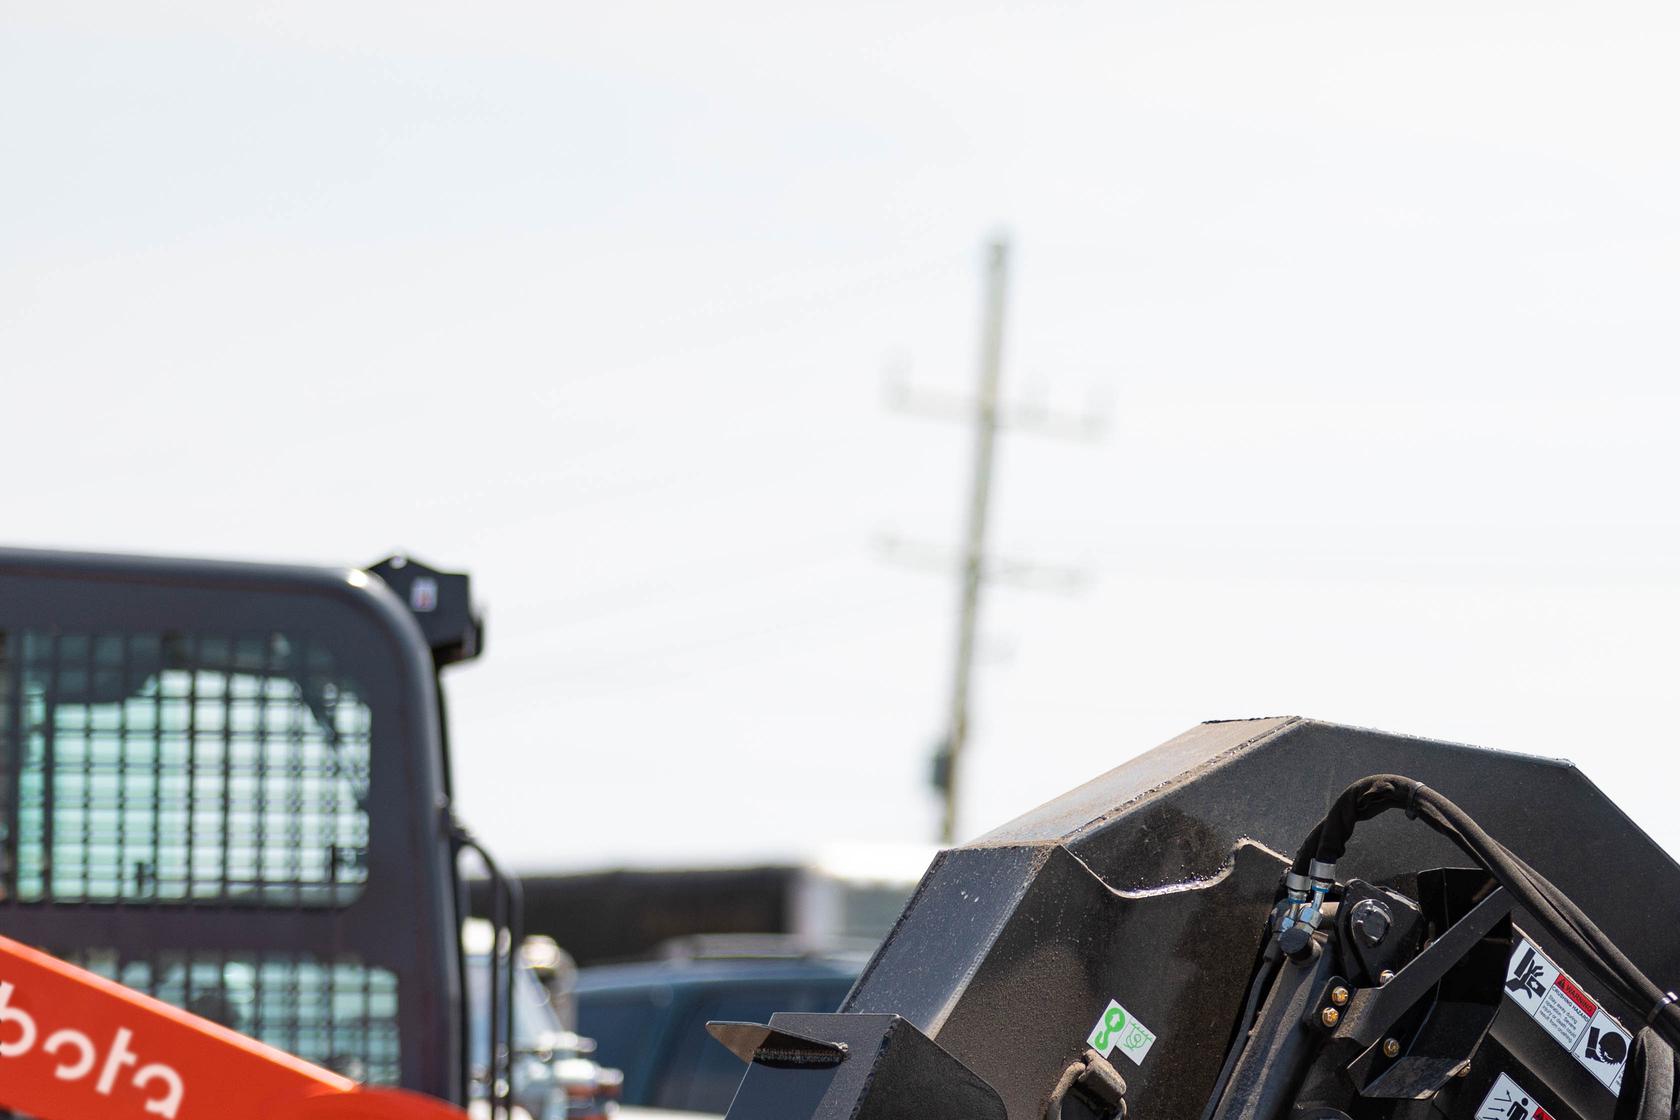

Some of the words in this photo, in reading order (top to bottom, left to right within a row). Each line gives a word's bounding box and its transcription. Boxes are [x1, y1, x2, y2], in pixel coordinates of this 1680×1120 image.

[1547, 993, 1558, 1005] Stay
[1555, 1002, 1566, 1014] away
[1564, 1010, 1578, 1025] during
[1550, 984, 1573, 1007] CRUSHING
[1564, 983, 1593, 1012] WARNING
[1538, 1009, 1550, 1021] result
[1548, 1018, 1558, 1028] from
[1540, 1004, 1553, 1017] injury
[1554, 1016, 1567, 1029] death
[1565, 1026, 1577, 1039] could
